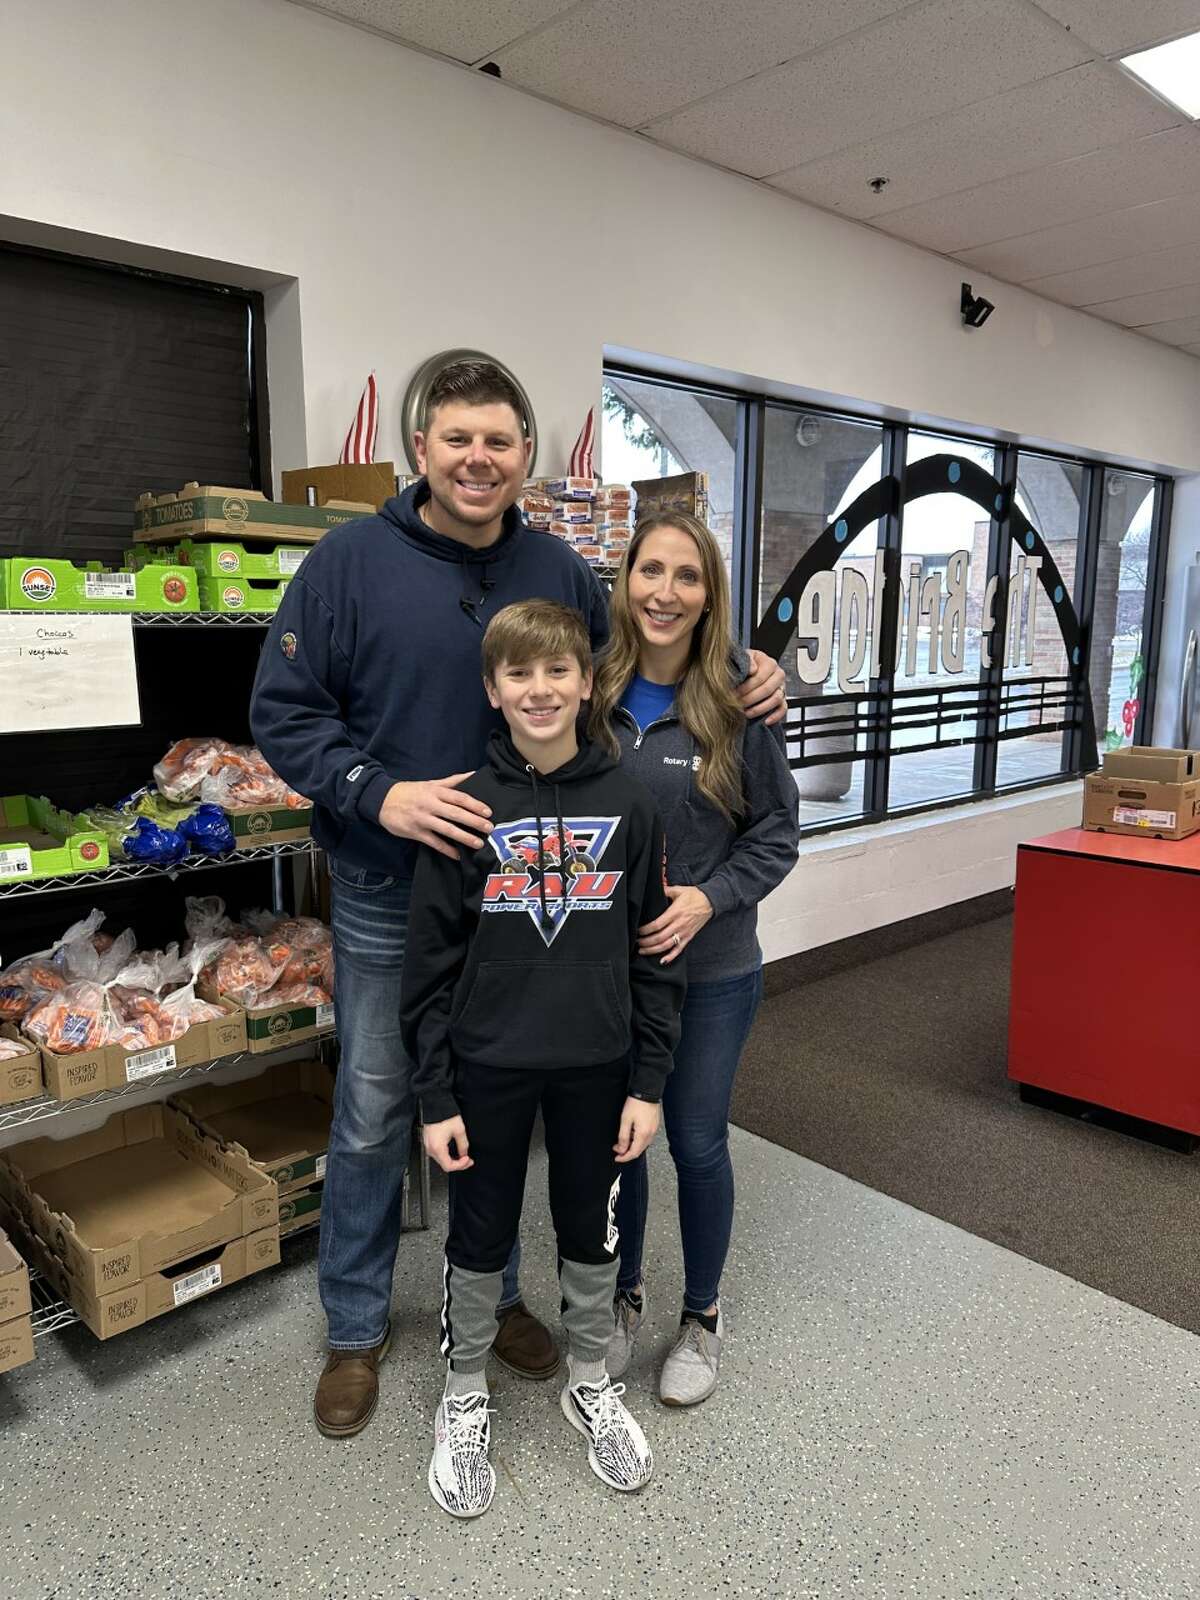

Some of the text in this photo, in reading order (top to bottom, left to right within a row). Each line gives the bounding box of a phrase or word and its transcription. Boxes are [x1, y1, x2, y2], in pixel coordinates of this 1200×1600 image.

[156, 502, 193, 522] TOMATOES
[22, 583, 55, 593] SUNSET
[663, 757, 688, 767] Rotary
[67, 1063, 98, 1077] INSPIRED
